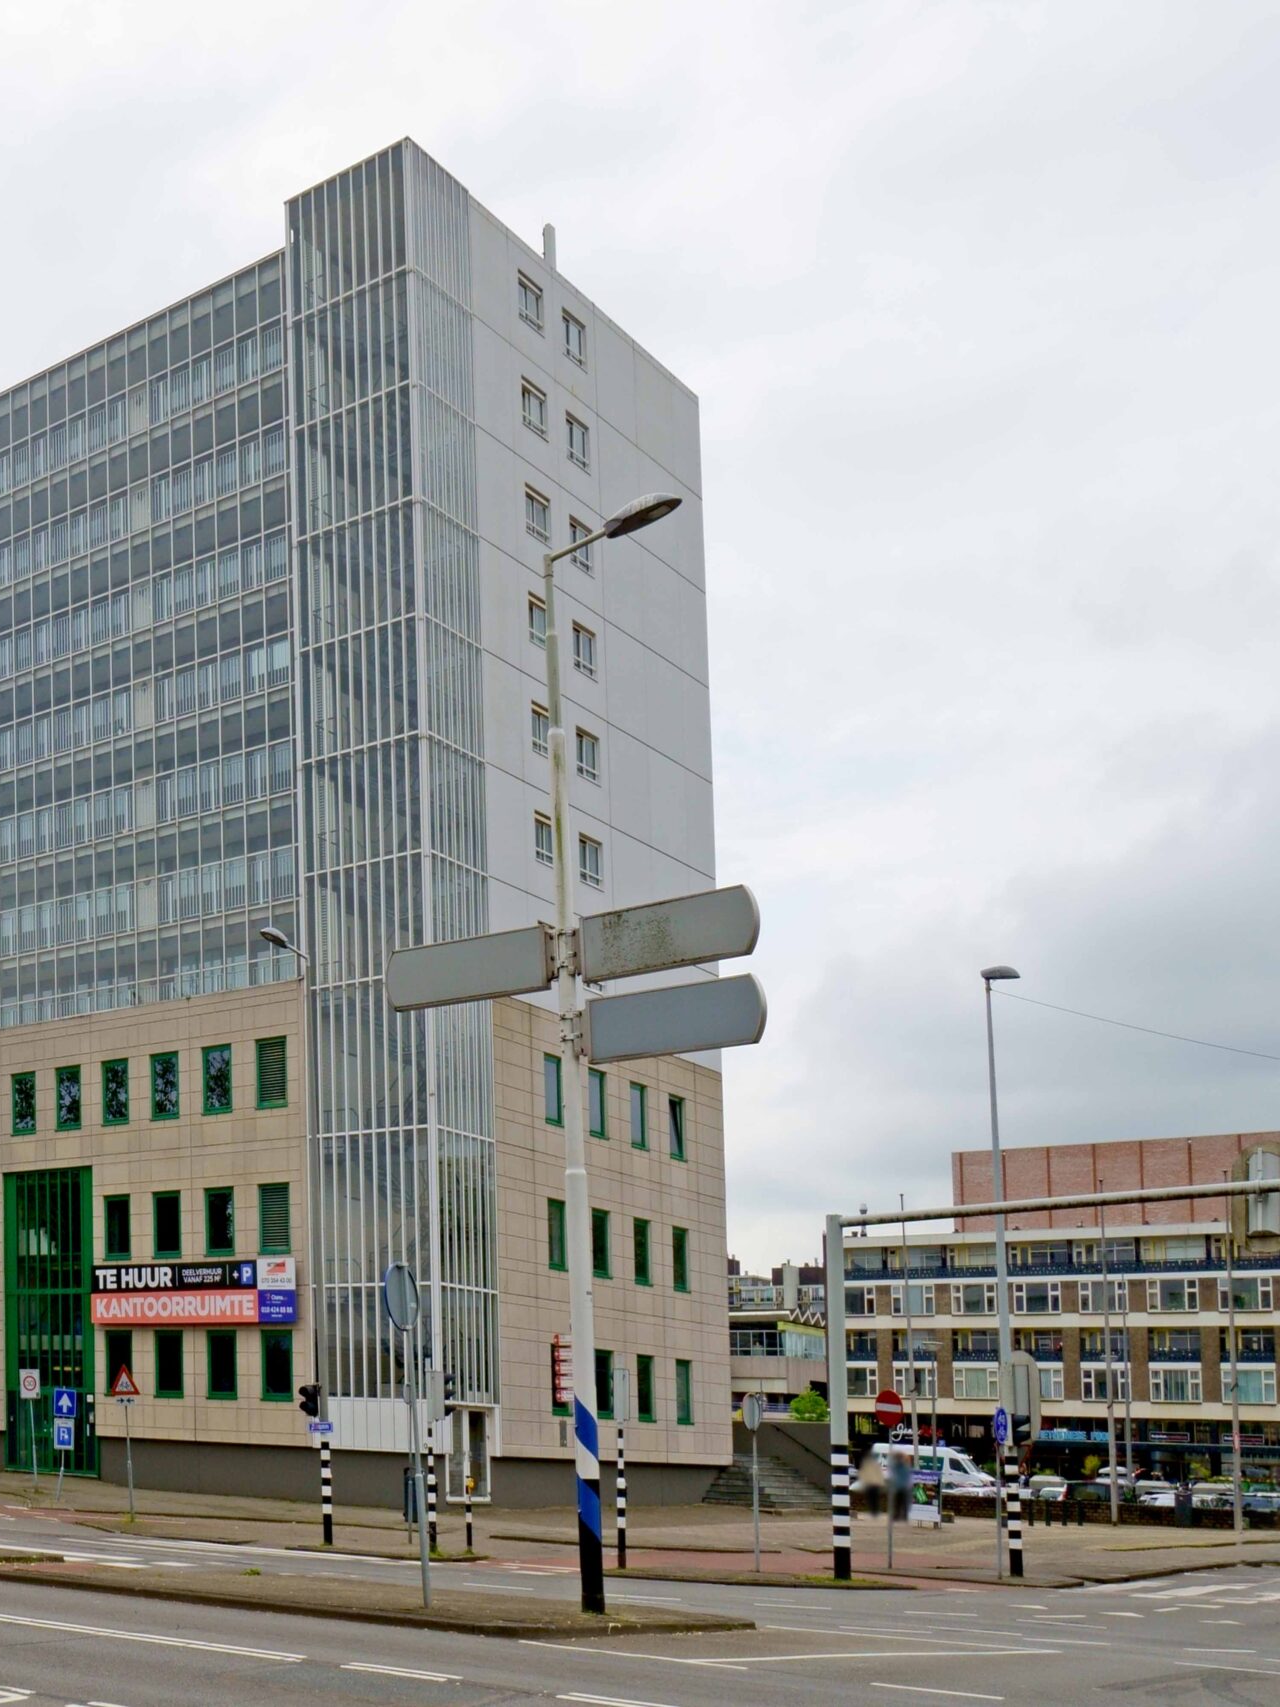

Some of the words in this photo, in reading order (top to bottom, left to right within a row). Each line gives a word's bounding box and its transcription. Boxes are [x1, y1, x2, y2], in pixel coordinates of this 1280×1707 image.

[95, 1268, 118, 1290] TE
[121, 1266, 173, 1289] HUUR
[181, 1267, 223, 1277] DEELVERHUUR
[183, 1275, 202, 1284] VANAF
[242, 1266, 252, 1282] P
[96, 1294, 255, 1318] KANTOORRUIMTE
